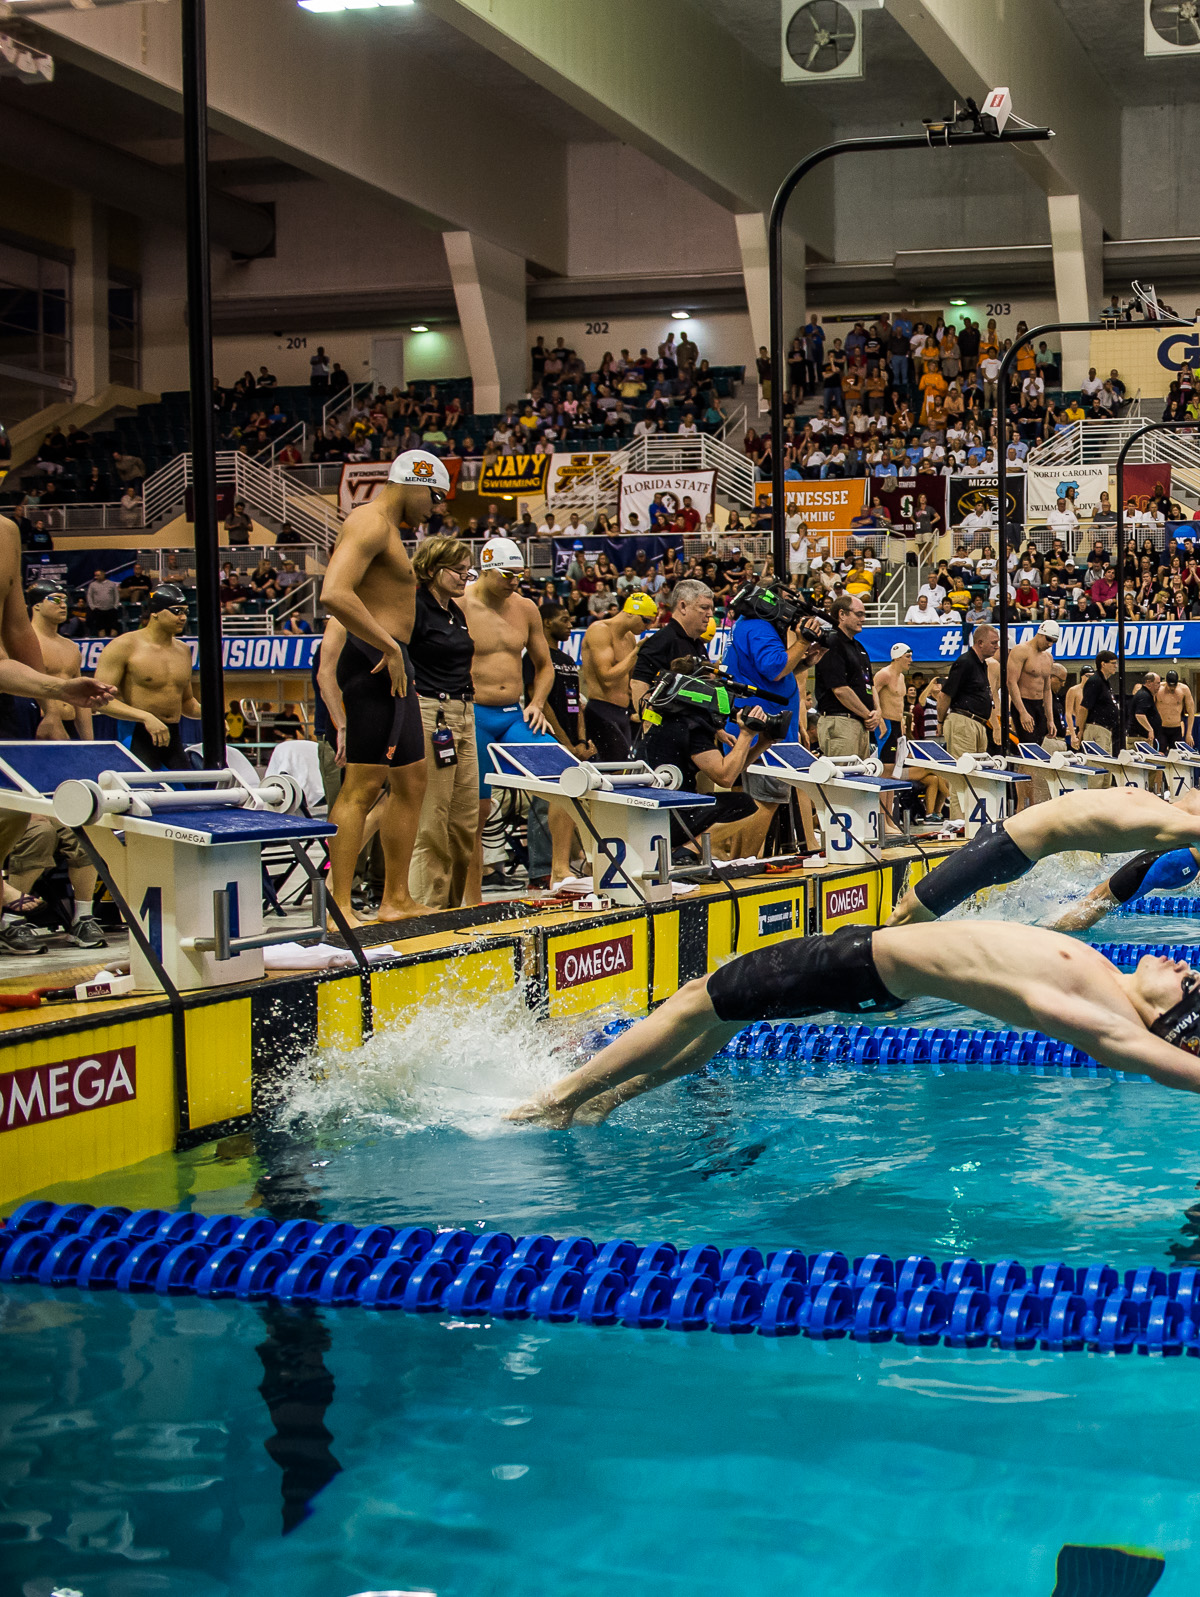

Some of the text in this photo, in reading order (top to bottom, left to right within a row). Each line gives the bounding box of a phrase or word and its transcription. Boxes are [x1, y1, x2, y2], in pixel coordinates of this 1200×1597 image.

[986, 303, 1011, 316] 203
[585, 322, 609, 334] 202
[286, 338, 308, 350] 201
[485, 454, 546, 476] NAVY
[1062, 469, 1103, 477] CAROLINA
[405, 476, 437, 484] MENDES
[483, 477, 540, 488] SWIMMING
[969, 478, 999, 487] MIZZO
[624, 479, 710, 495] FLORIDA STATE
[1030, 504, 1057, 512] SWIMM
[1173, 776, 1185, 797] 7
[634, 799, 655, 808] OMEGA
[969, 797, 988, 825] 4
[175, 831, 206, 844] OMEGA
[830, 812, 853, 851] 3
[597, 837, 627, 889] 2
[829, 887, 865, 914] OMEGA
[139, 887, 164, 965] 1
[563, 942, 629, 982] OMEGA
